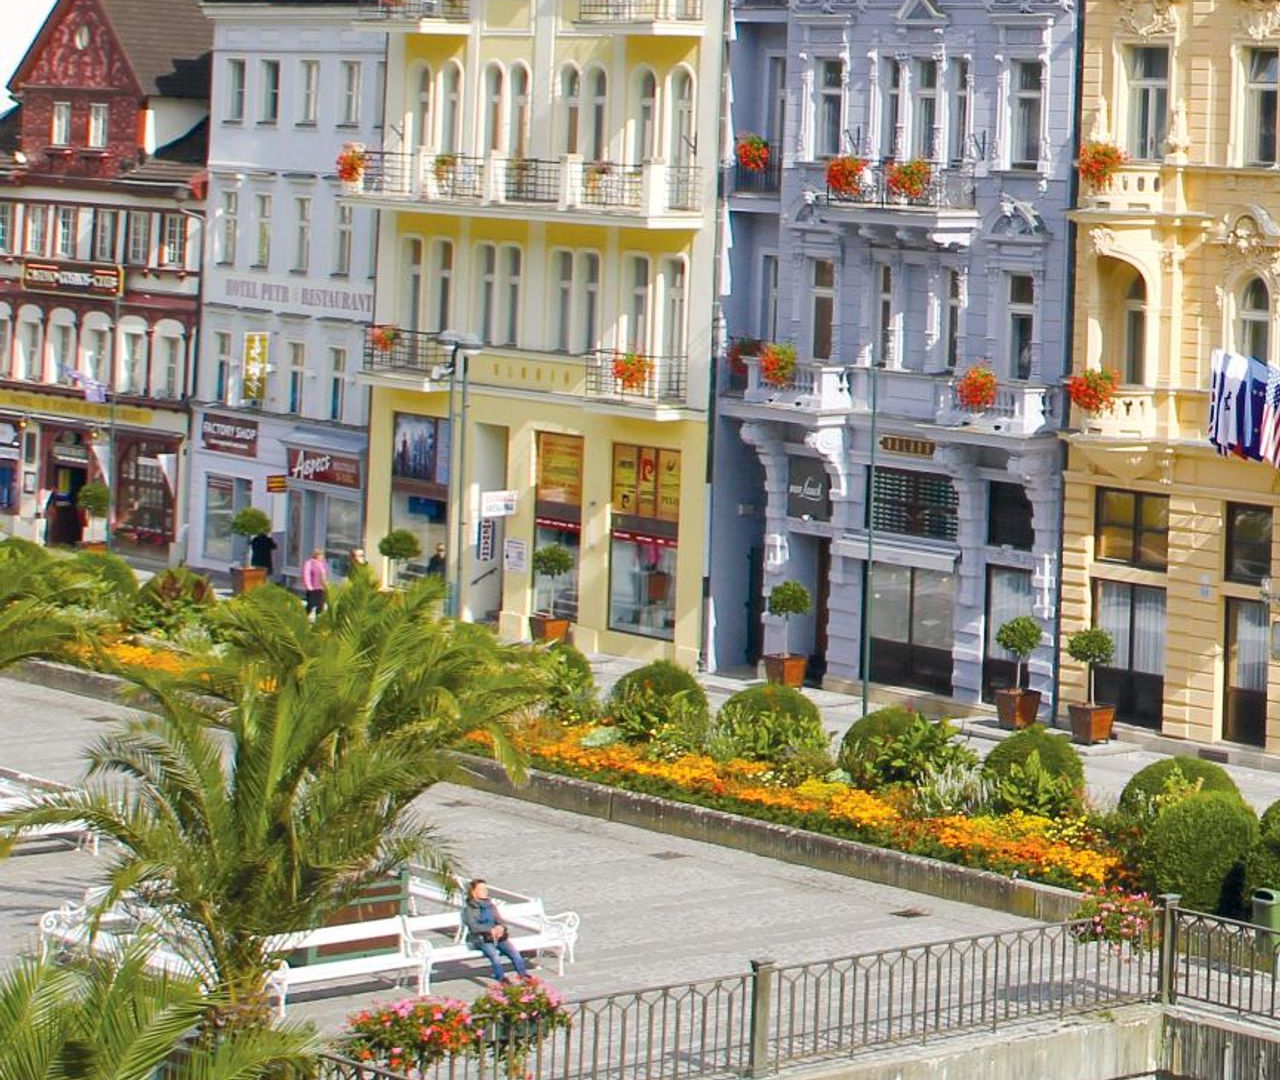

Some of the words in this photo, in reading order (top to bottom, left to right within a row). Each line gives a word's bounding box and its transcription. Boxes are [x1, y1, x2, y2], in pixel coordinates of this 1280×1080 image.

[225, 278, 258, 299] HOTEL
[301, 287, 373, 313] RESTAURANT
[203, 421, 235, 438] FACTORY
[235, 426, 257, 441] SHOP
